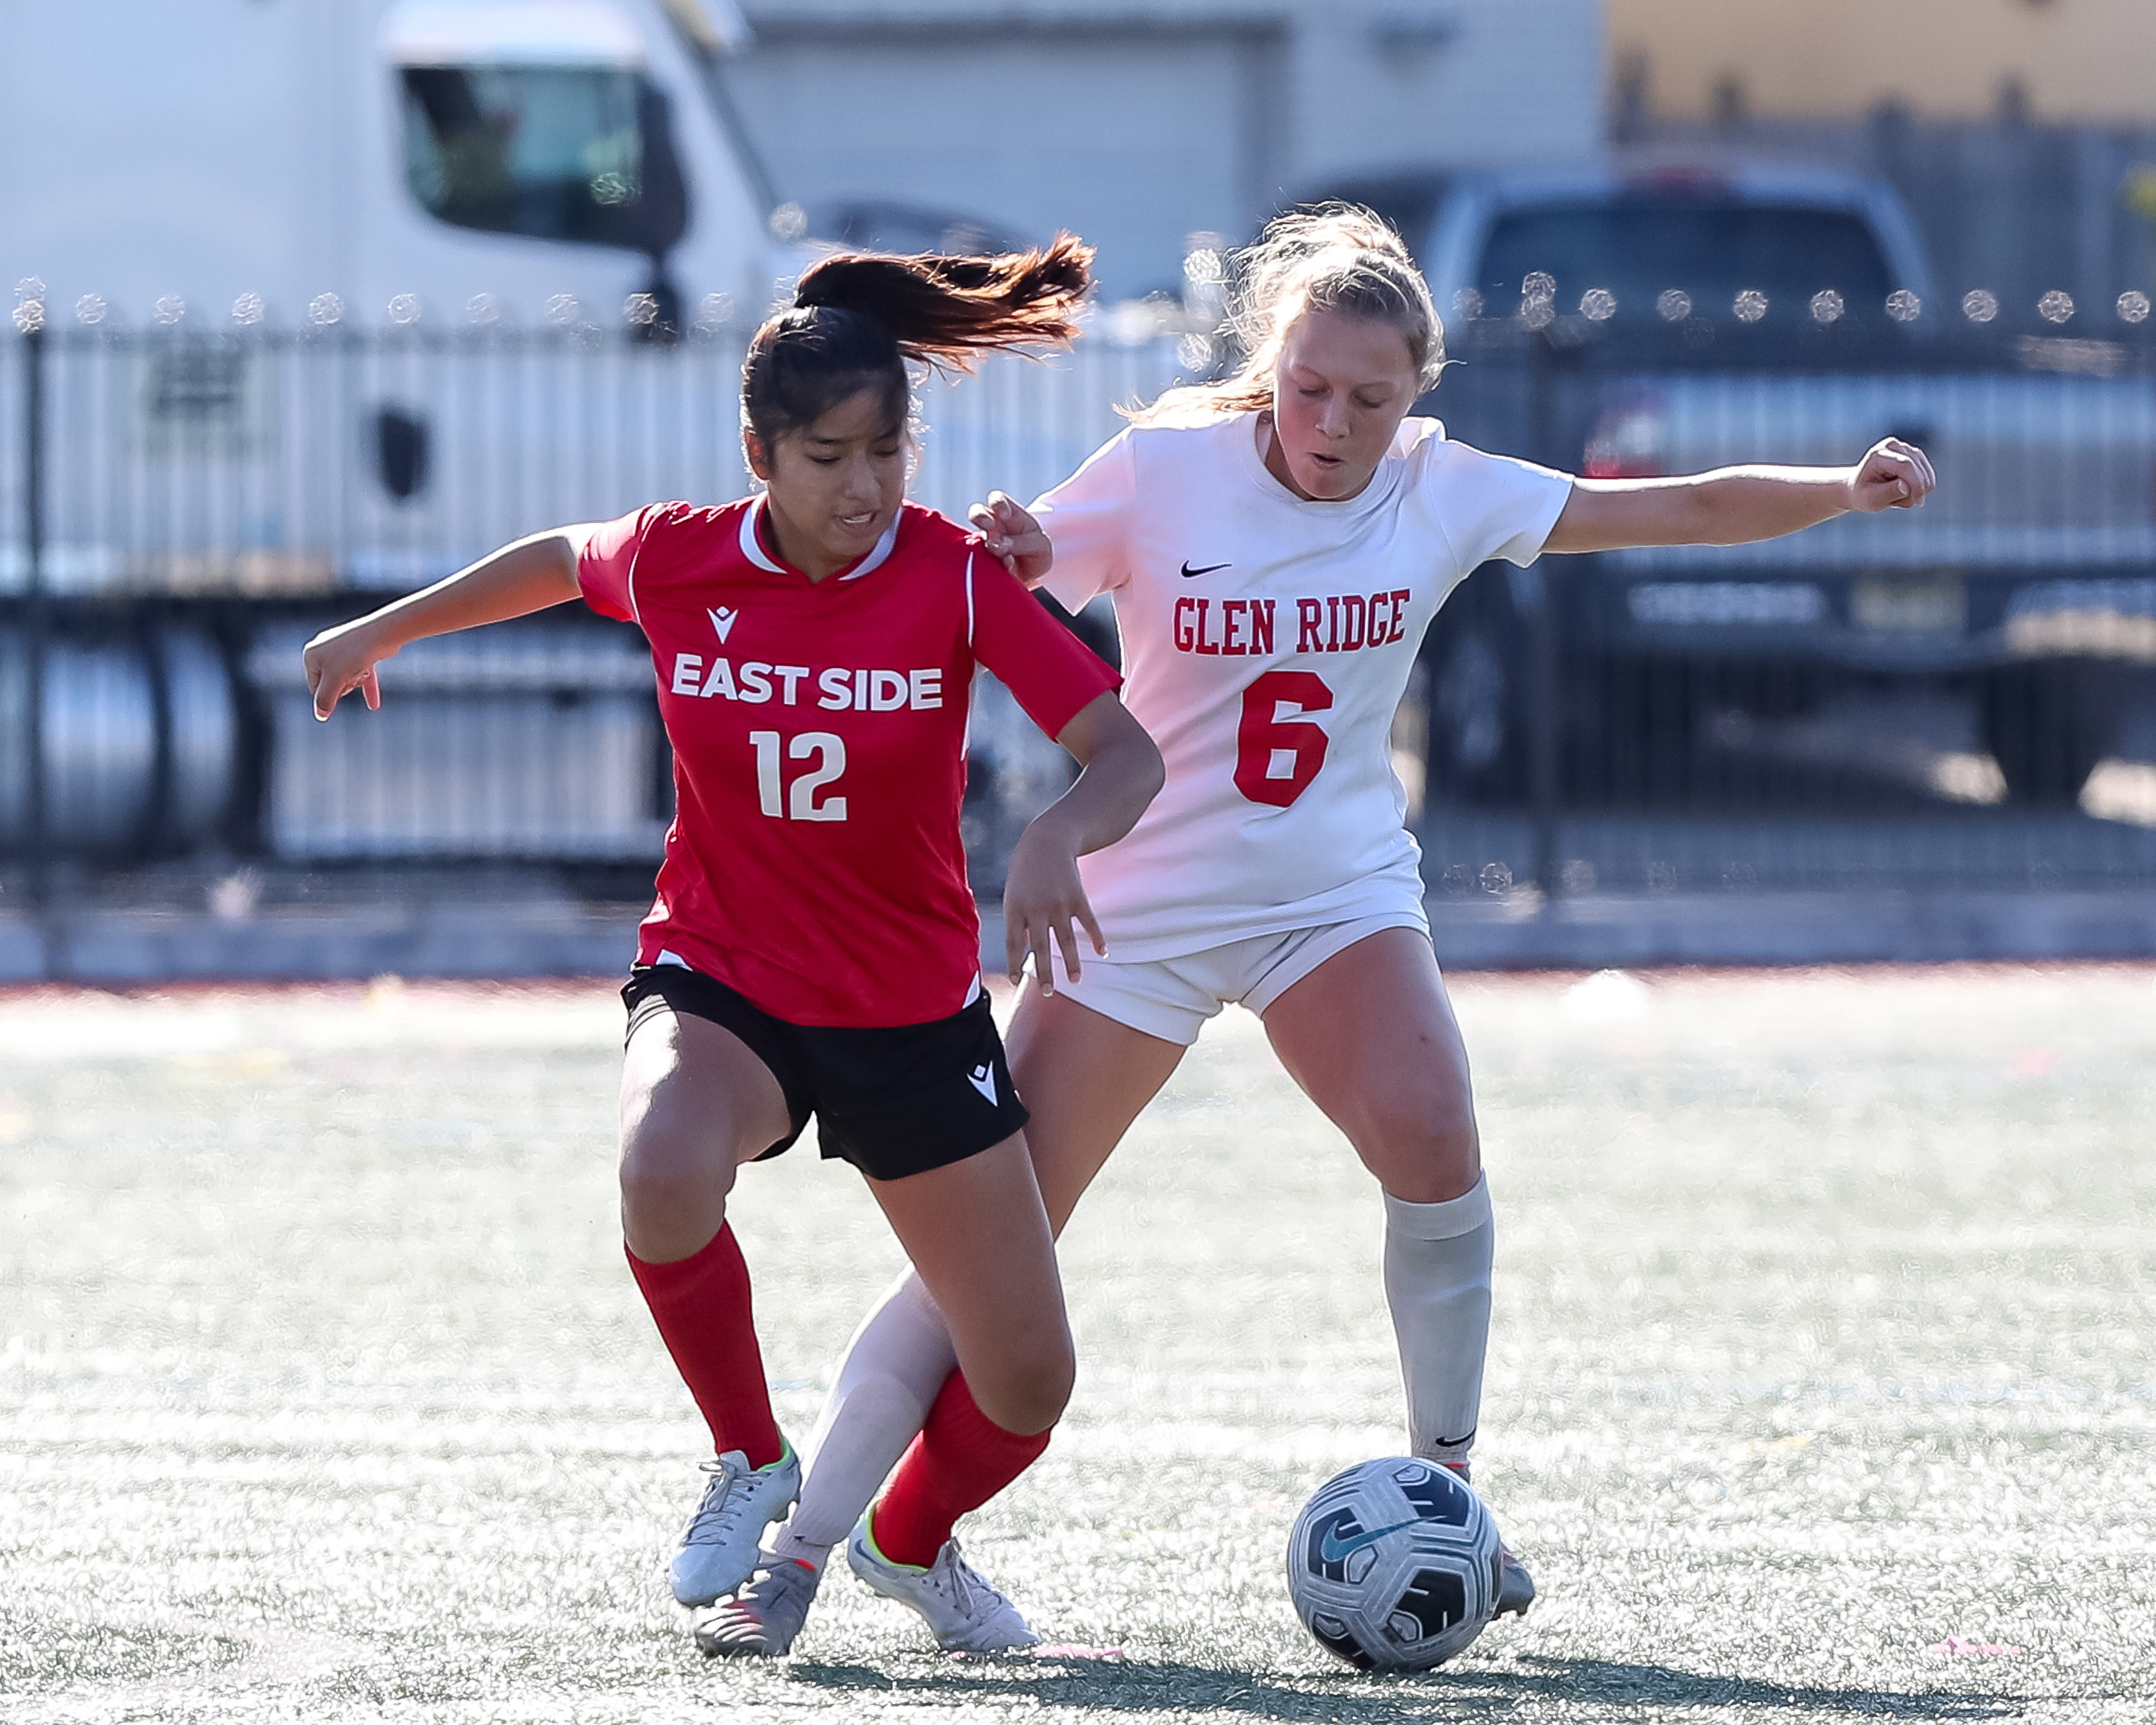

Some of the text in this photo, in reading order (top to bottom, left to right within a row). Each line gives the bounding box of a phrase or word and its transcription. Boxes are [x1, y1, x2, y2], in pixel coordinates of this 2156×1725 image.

[1173, 588, 1411, 655] GLEN RIDGE
[671, 653, 943, 712] EAST SIDE
[749, 730, 847, 821] 12
[1233, 670, 1334, 808] 6
